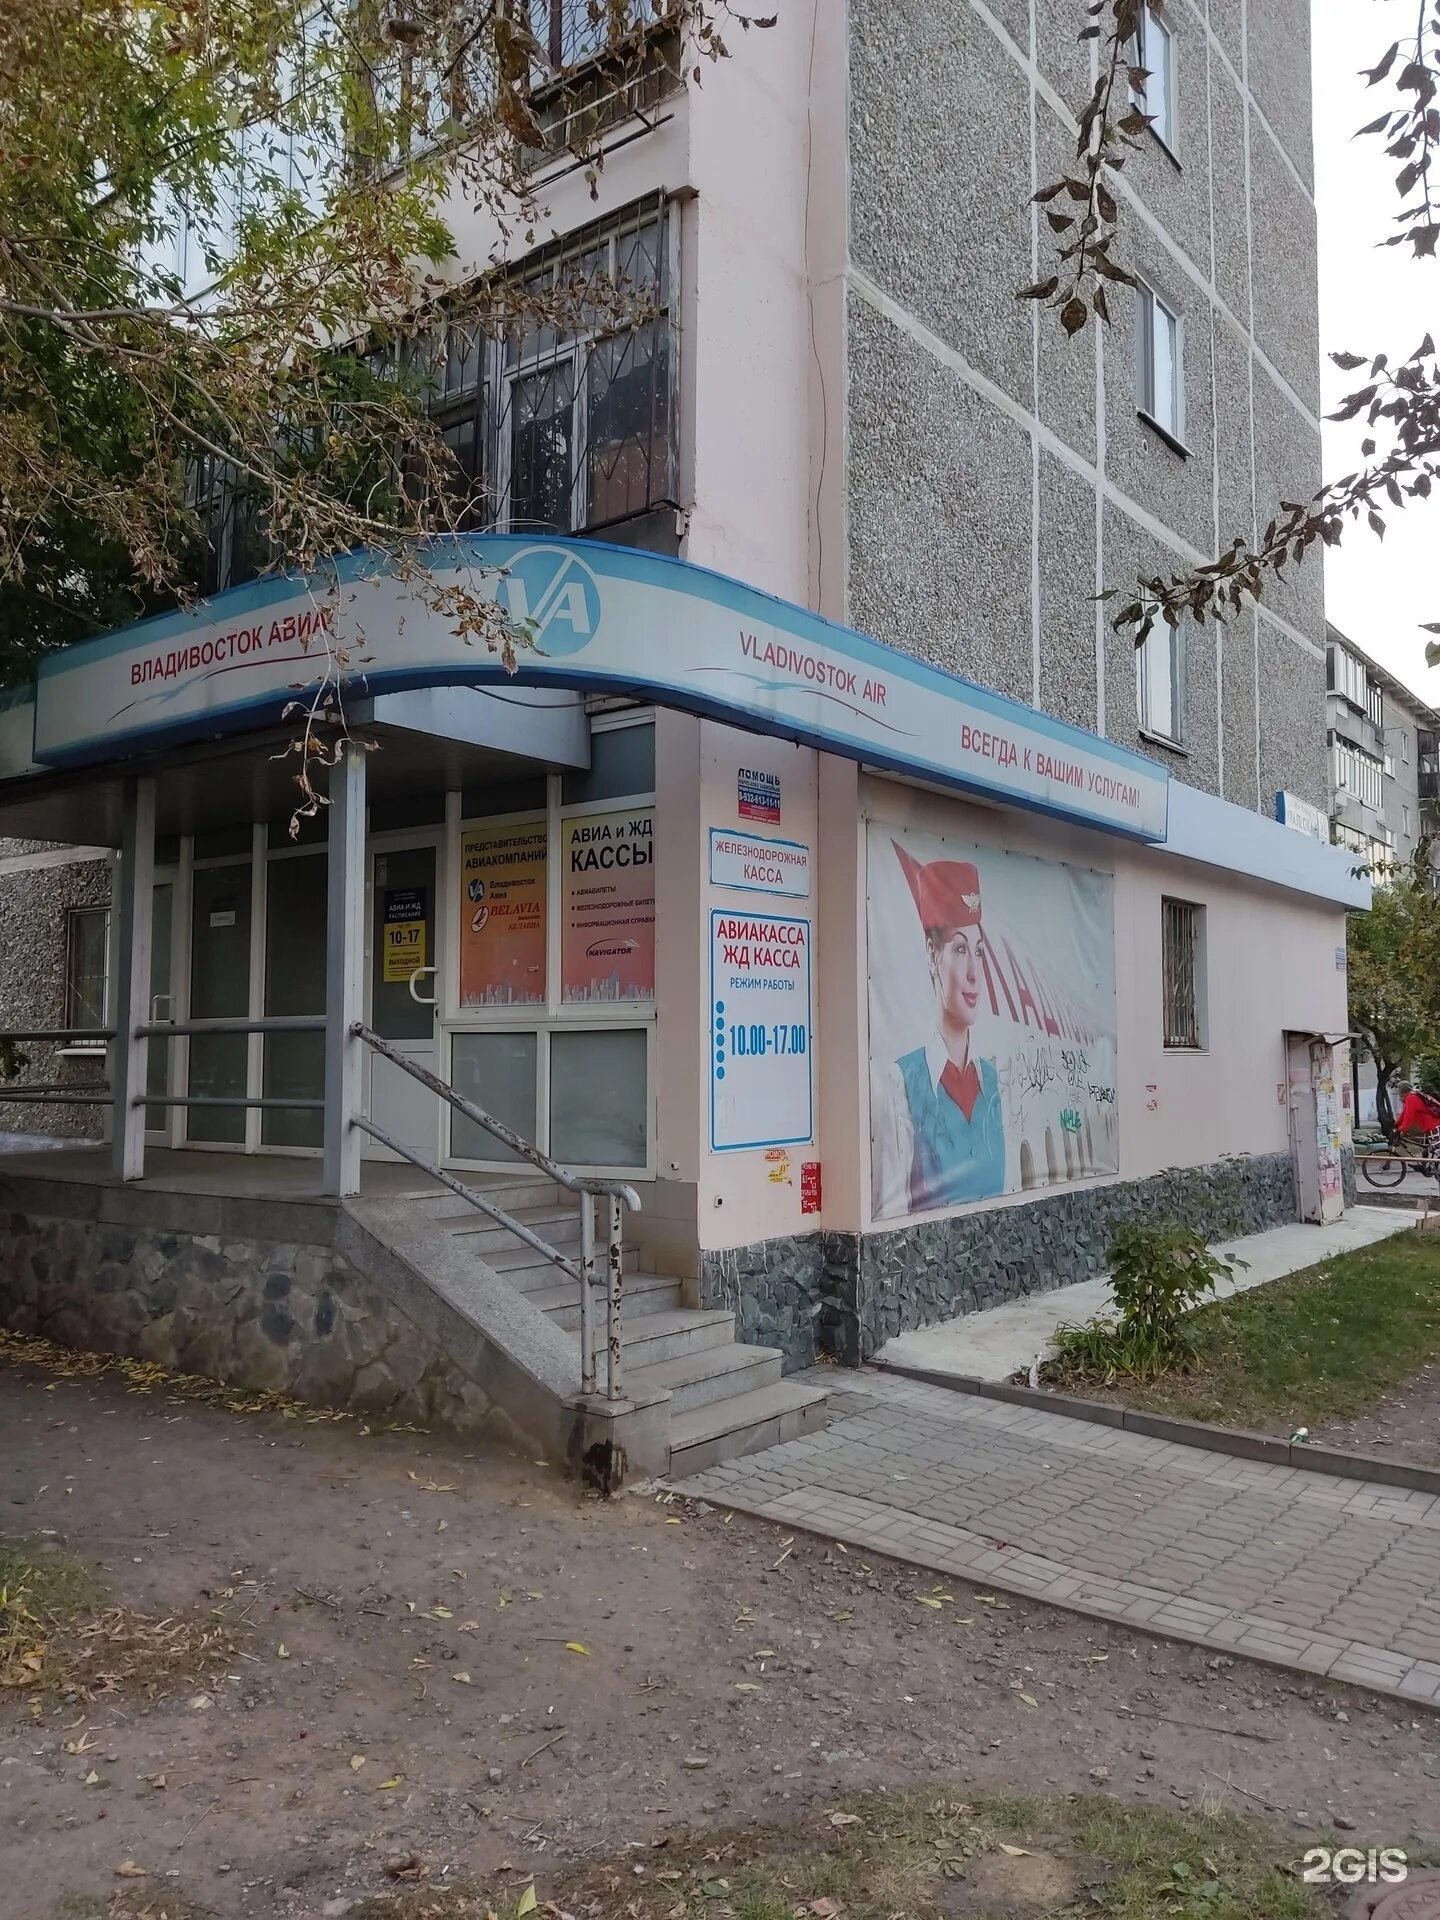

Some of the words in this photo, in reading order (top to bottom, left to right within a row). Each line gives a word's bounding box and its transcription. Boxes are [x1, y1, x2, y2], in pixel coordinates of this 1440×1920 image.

[130, 622, 263, 687] ВЛАДИВОСТОК
[740, 631, 857, 692] VLADIVOSTOK
[862, 678, 887, 707] AIR
[738, 768, 780, 786] ПОМОЩЬ
[960, 724, 1018, 767] ВСЕГДА
[1023, 747, 1034, 769] К
[1037, 751, 1084, 789] ВАШИМ
[1088, 770, 1141, 809] УСЛУГАМ!
[571, 825, 612, 844] АВИА
[629, 819, 653, 838] ЖД
[465, 846, 548, 870] АВИАКОМПАНИЙ
[571, 841, 654, 873] КАССЫ
[715, 840, 807, 867] ЖЕЛЕЗНОДОРОЖНАЯ
[489, 879, 536, 889] Владивосток
[743, 863, 784, 884] КАССА
[489, 892, 507, 900] Авиа
[576, 886, 617, 896] АВИАБИЛЕТЫ
[490, 902, 540, 916] BELAVIA
[576, 900, 634, 912] ЖЕЛЕЗНОДОРОЖНЫЕ
[389, 929, 421, 945] 10-17
[717, 919, 805, 946] АВИАКАССА
[588, 948, 632, 957] NAVIGATOR
[723, 944, 751, 970] ЖД
[754, 946, 800, 968] КАССА
[730, 977, 761, 990] РЕЖИМ
[763, 979, 795, 991] РАБОТЫ
[729, 1024, 806, 1056] 10.00-17.00
